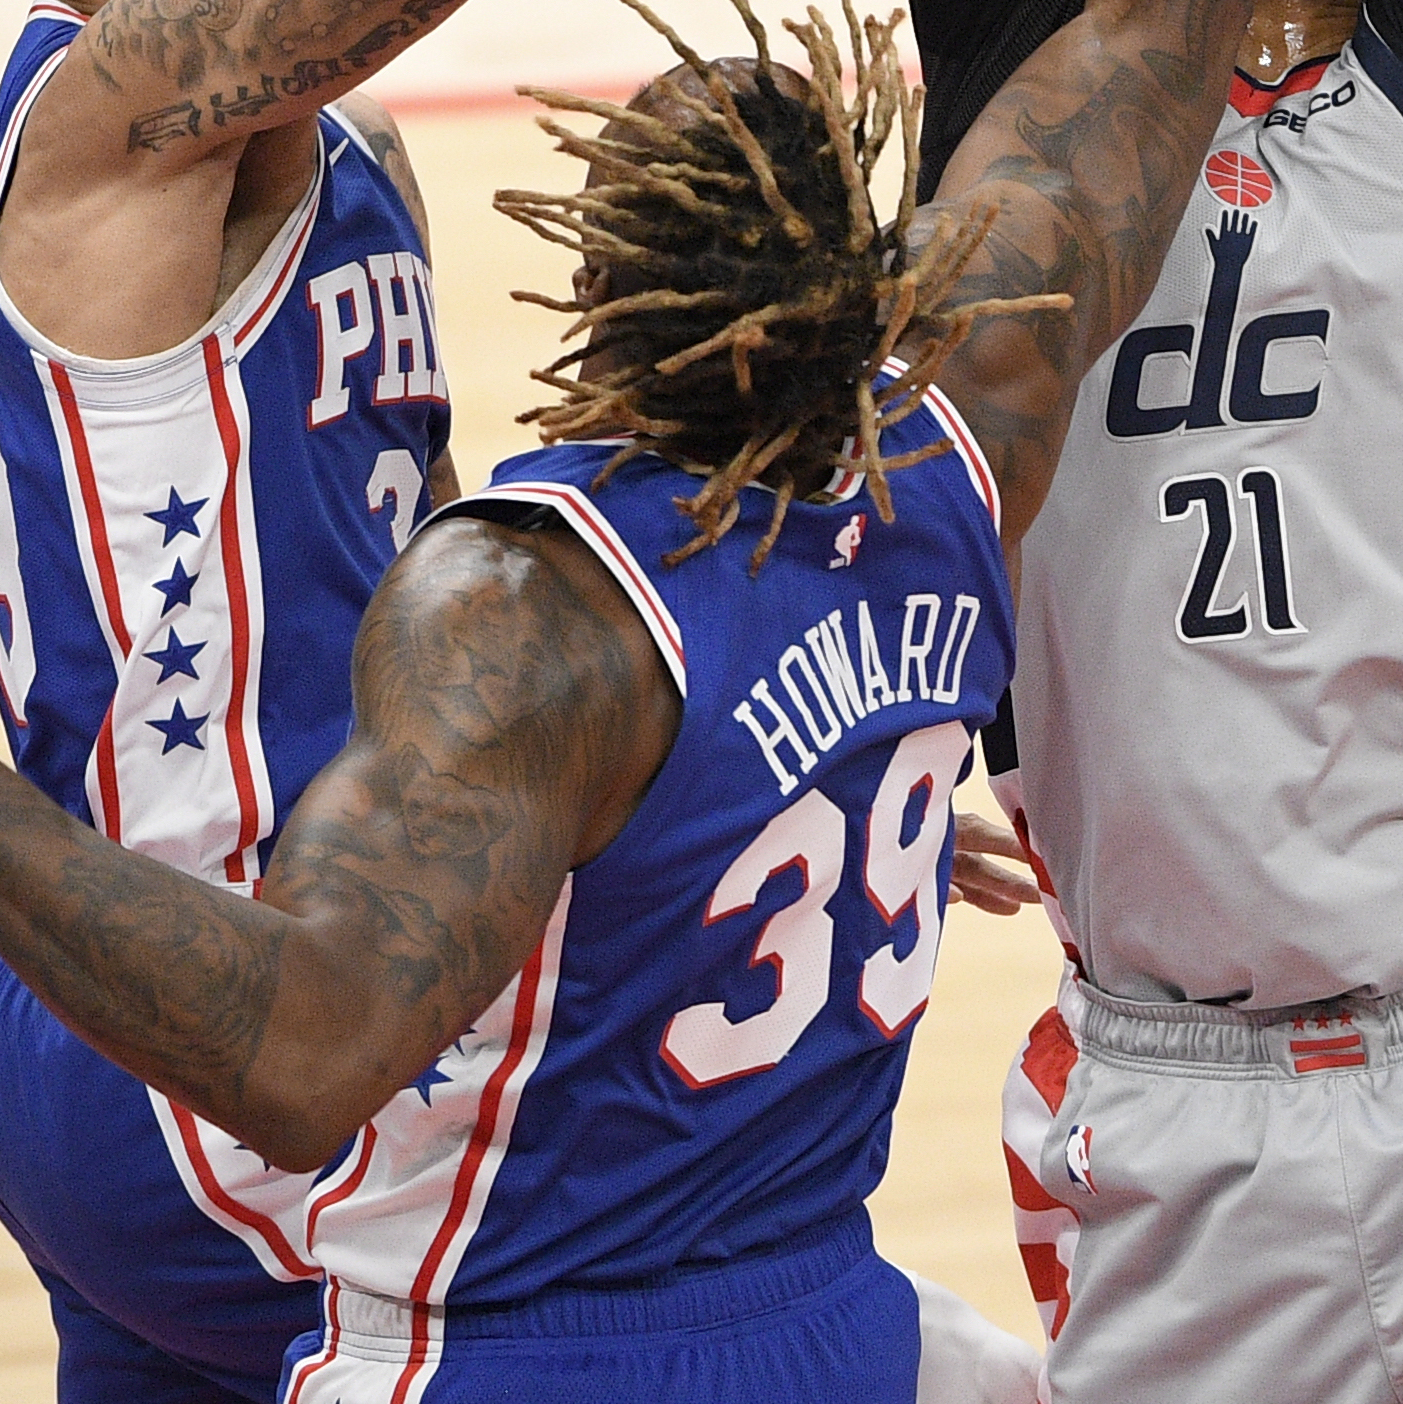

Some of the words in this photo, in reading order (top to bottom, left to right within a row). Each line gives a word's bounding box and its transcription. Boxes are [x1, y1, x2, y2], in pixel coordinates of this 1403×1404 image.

[306, 250, 448, 431] PHI
[1158, 465, 1309, 645] 21
[733, 592, 982, 796] HOWARD
[658, 719, 972, 1091] 39
